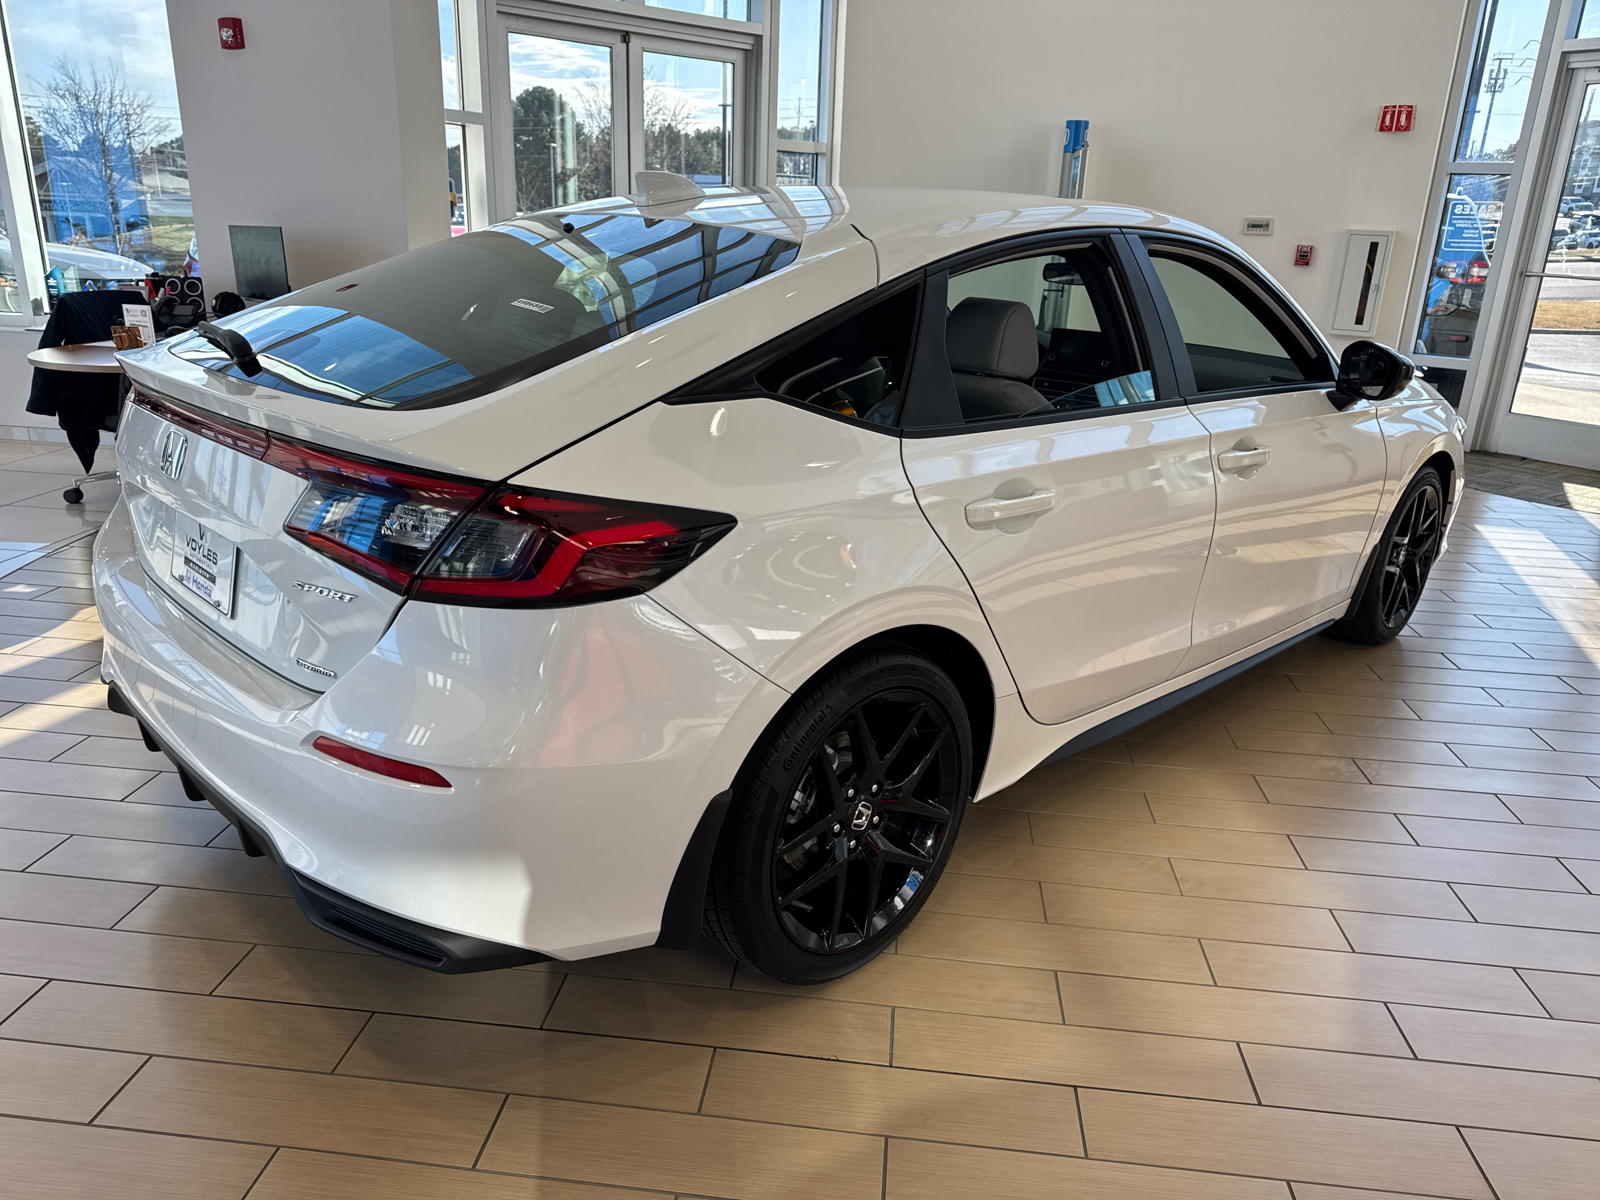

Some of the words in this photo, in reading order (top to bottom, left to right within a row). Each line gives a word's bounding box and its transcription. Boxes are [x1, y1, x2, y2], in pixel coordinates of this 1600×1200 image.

[40, 202, 63, 211] PITAL
[186, 534, 218, 566] VOYLES
[192, 575, 213, 598] Honda
[291, 580, 359, 603] SPORT
[299, 660, 334, 677] HYBRID
[783, 708, 828, 772] Continental
